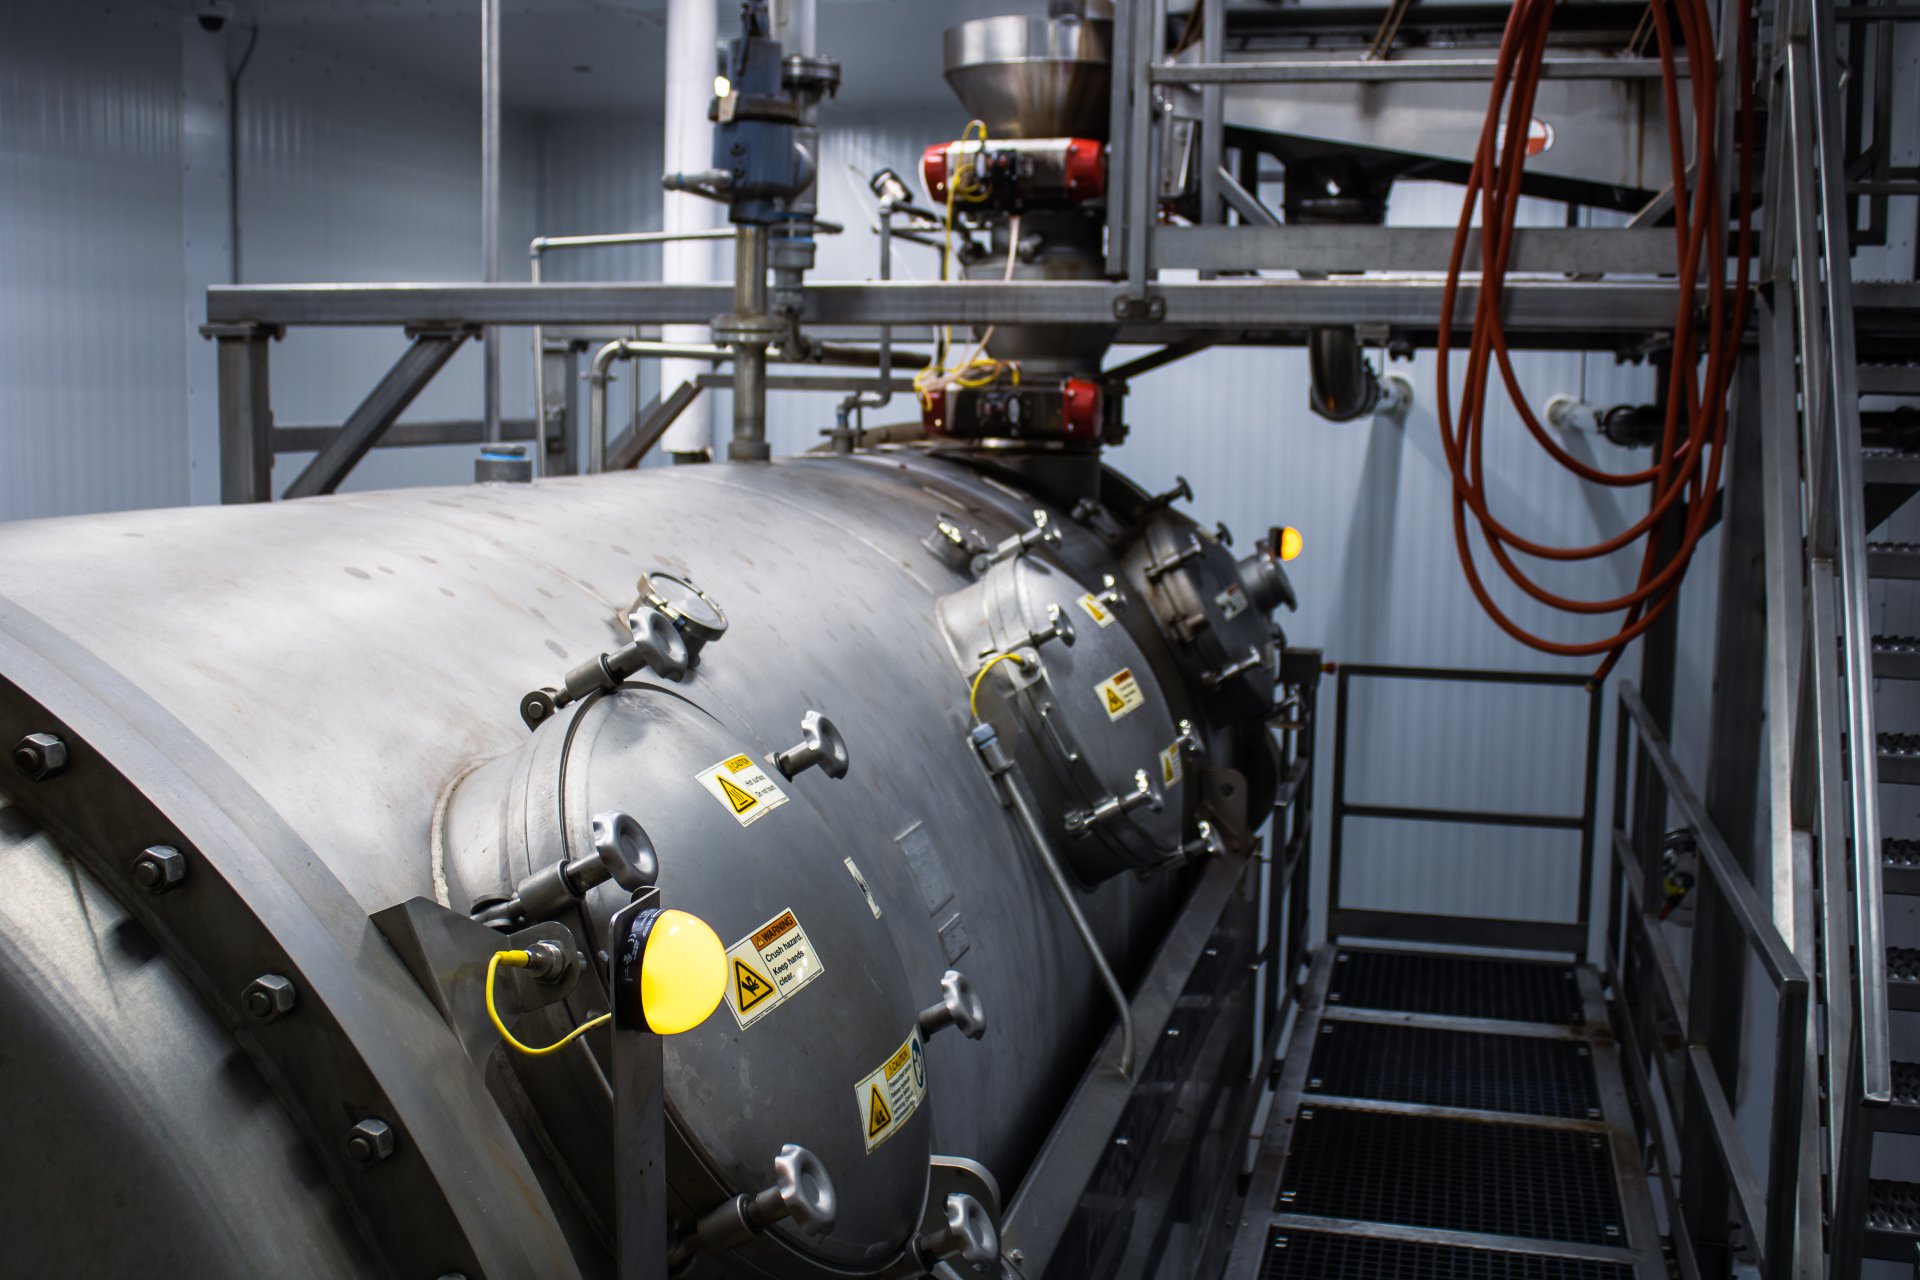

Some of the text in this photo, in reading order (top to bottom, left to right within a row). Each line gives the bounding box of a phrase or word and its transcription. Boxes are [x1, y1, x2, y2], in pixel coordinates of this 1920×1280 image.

[762, 917, 793, 941] WARNING
[765, 932, 804, 963] Crush hazard.
[772, 961, 789, 976] Keep
[786, 950, 805, 966] hands
[779, 972, 796, 987] clear.
